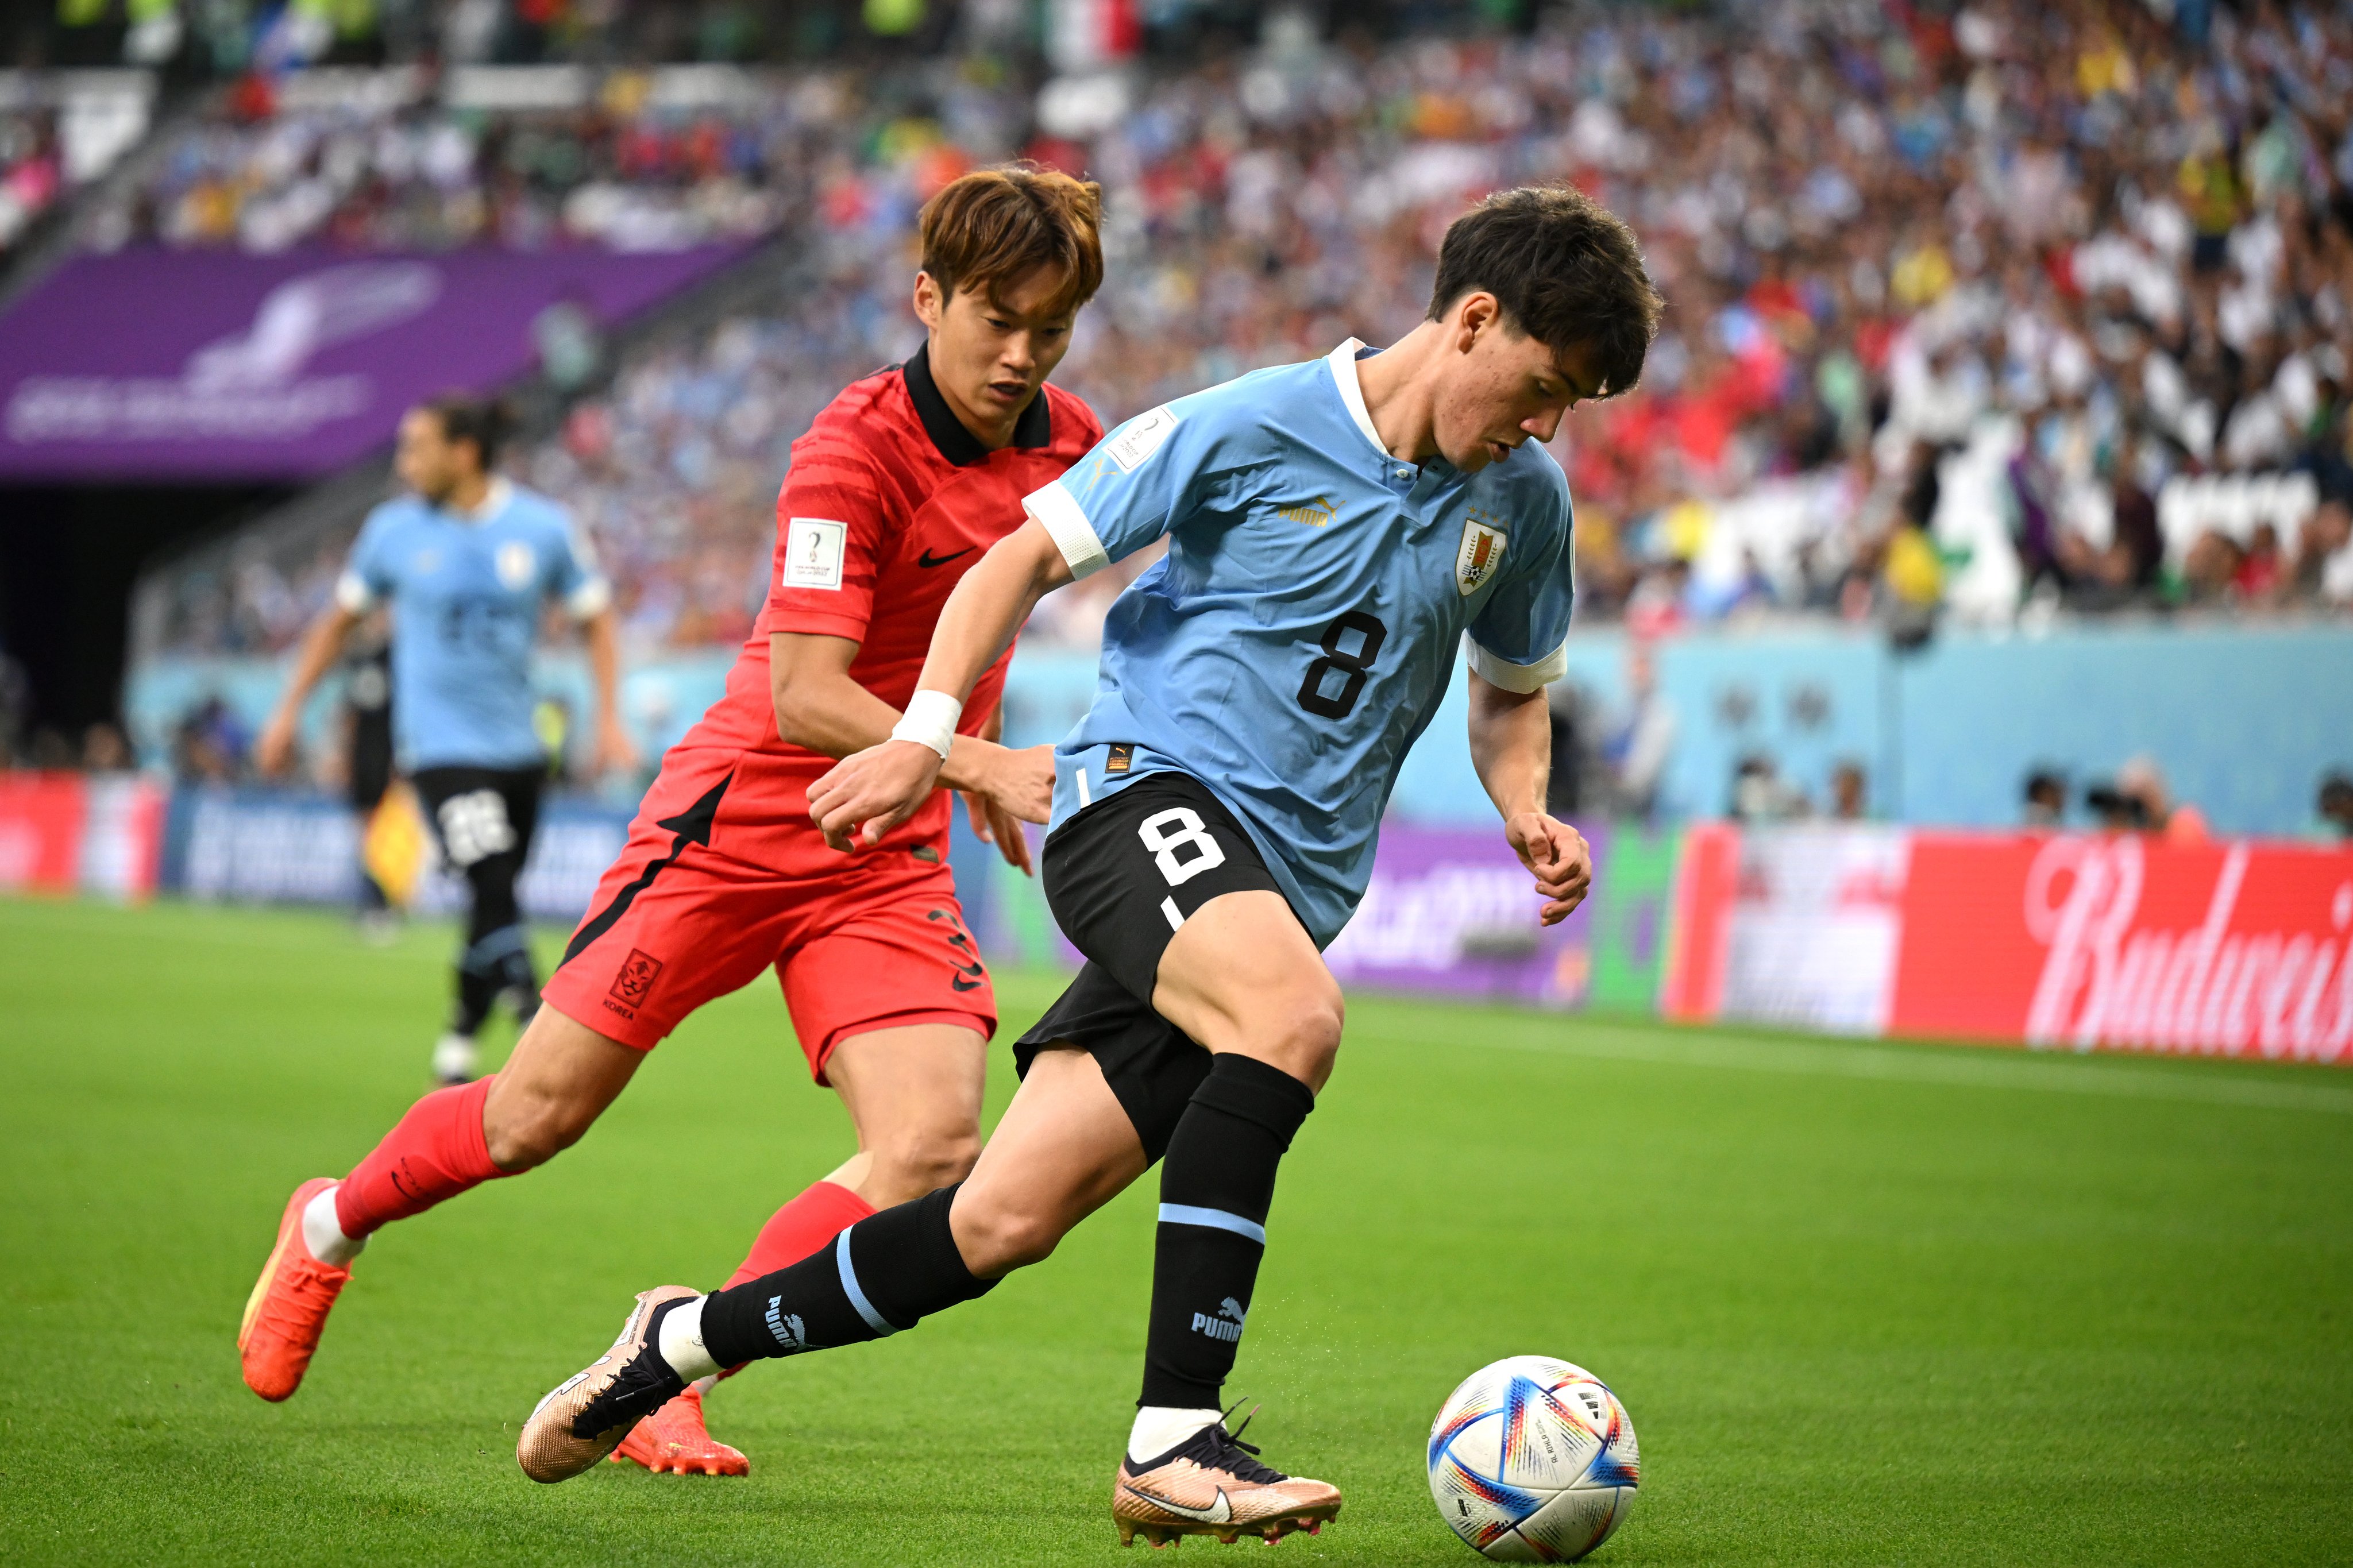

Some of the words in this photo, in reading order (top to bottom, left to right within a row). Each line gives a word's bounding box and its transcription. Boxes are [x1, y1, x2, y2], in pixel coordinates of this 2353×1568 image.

[1278, 504, 1329, 527] PUMA
[1296, 611, 1387, 720] 8
[1137, 807, 1226, 886] 8
[603, 999, 634, 1021] KOREA
[765, 1295, 797, 1349] PUMA
[1191, 1312, 1242, 1342] PUMA
[1541, 1435, 1554, 1454] RIHLA
[1550, 1454, 1559, 1464] AL
